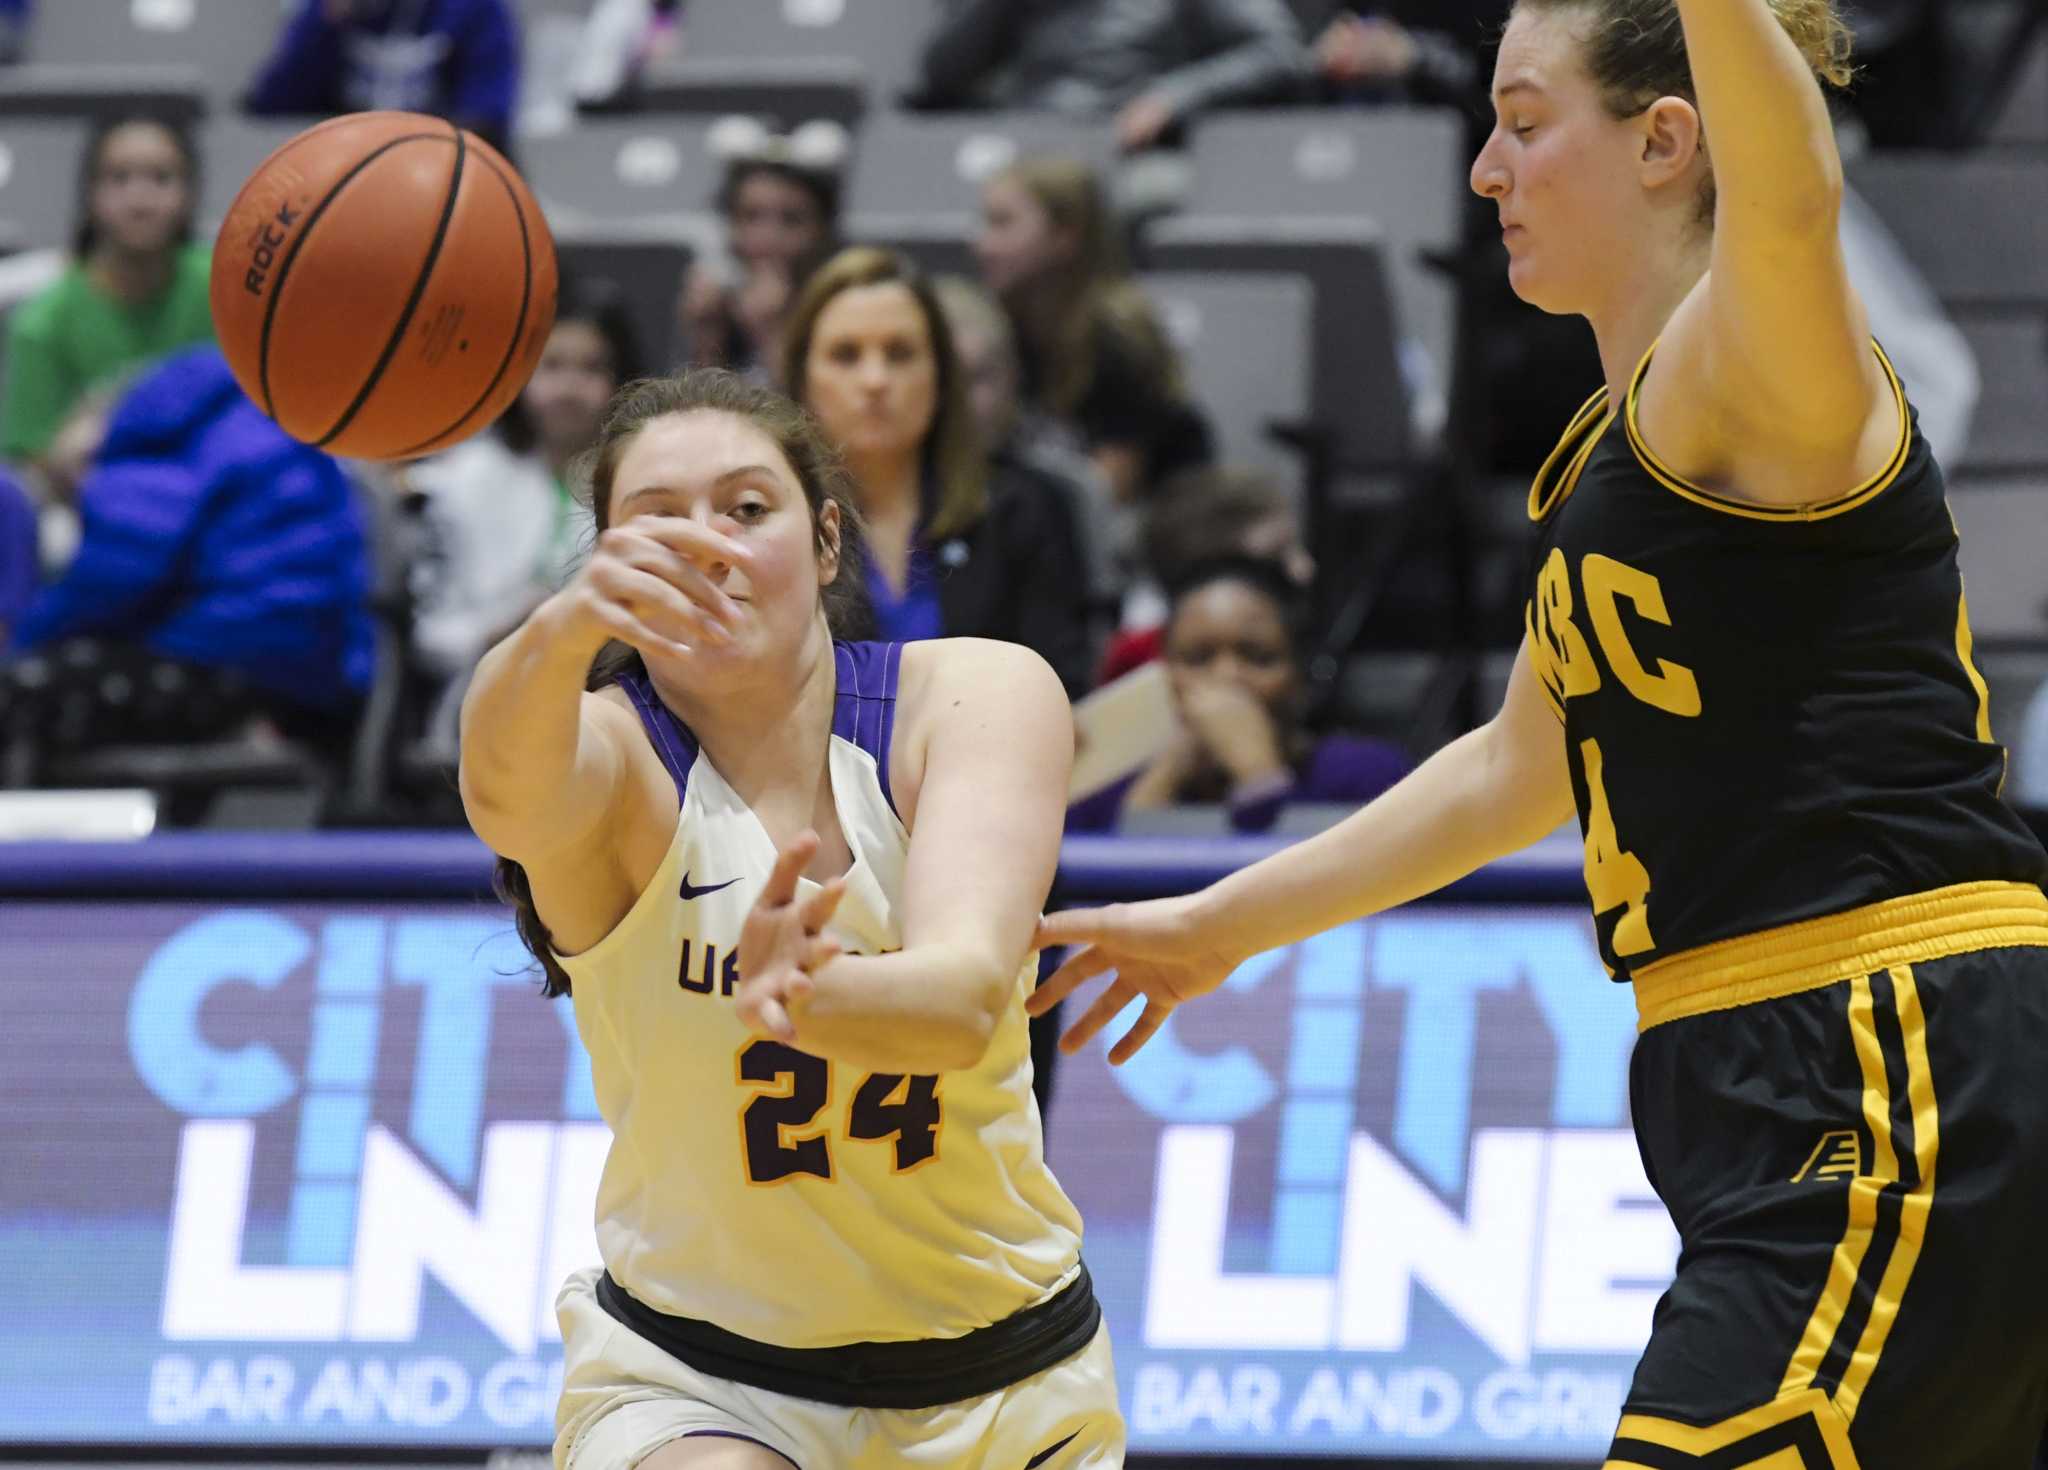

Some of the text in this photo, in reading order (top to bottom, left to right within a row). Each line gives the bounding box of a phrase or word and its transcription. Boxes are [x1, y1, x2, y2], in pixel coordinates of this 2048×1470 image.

[245, 200, 302, 296] ROCK
[735, 1034, 945, 1188] 24
[147, 1354, 297, 1428] BAR
[303, 1354, 471, 1429] AND
[1131, 1361, 1624, 1441] BAR AND GRI
